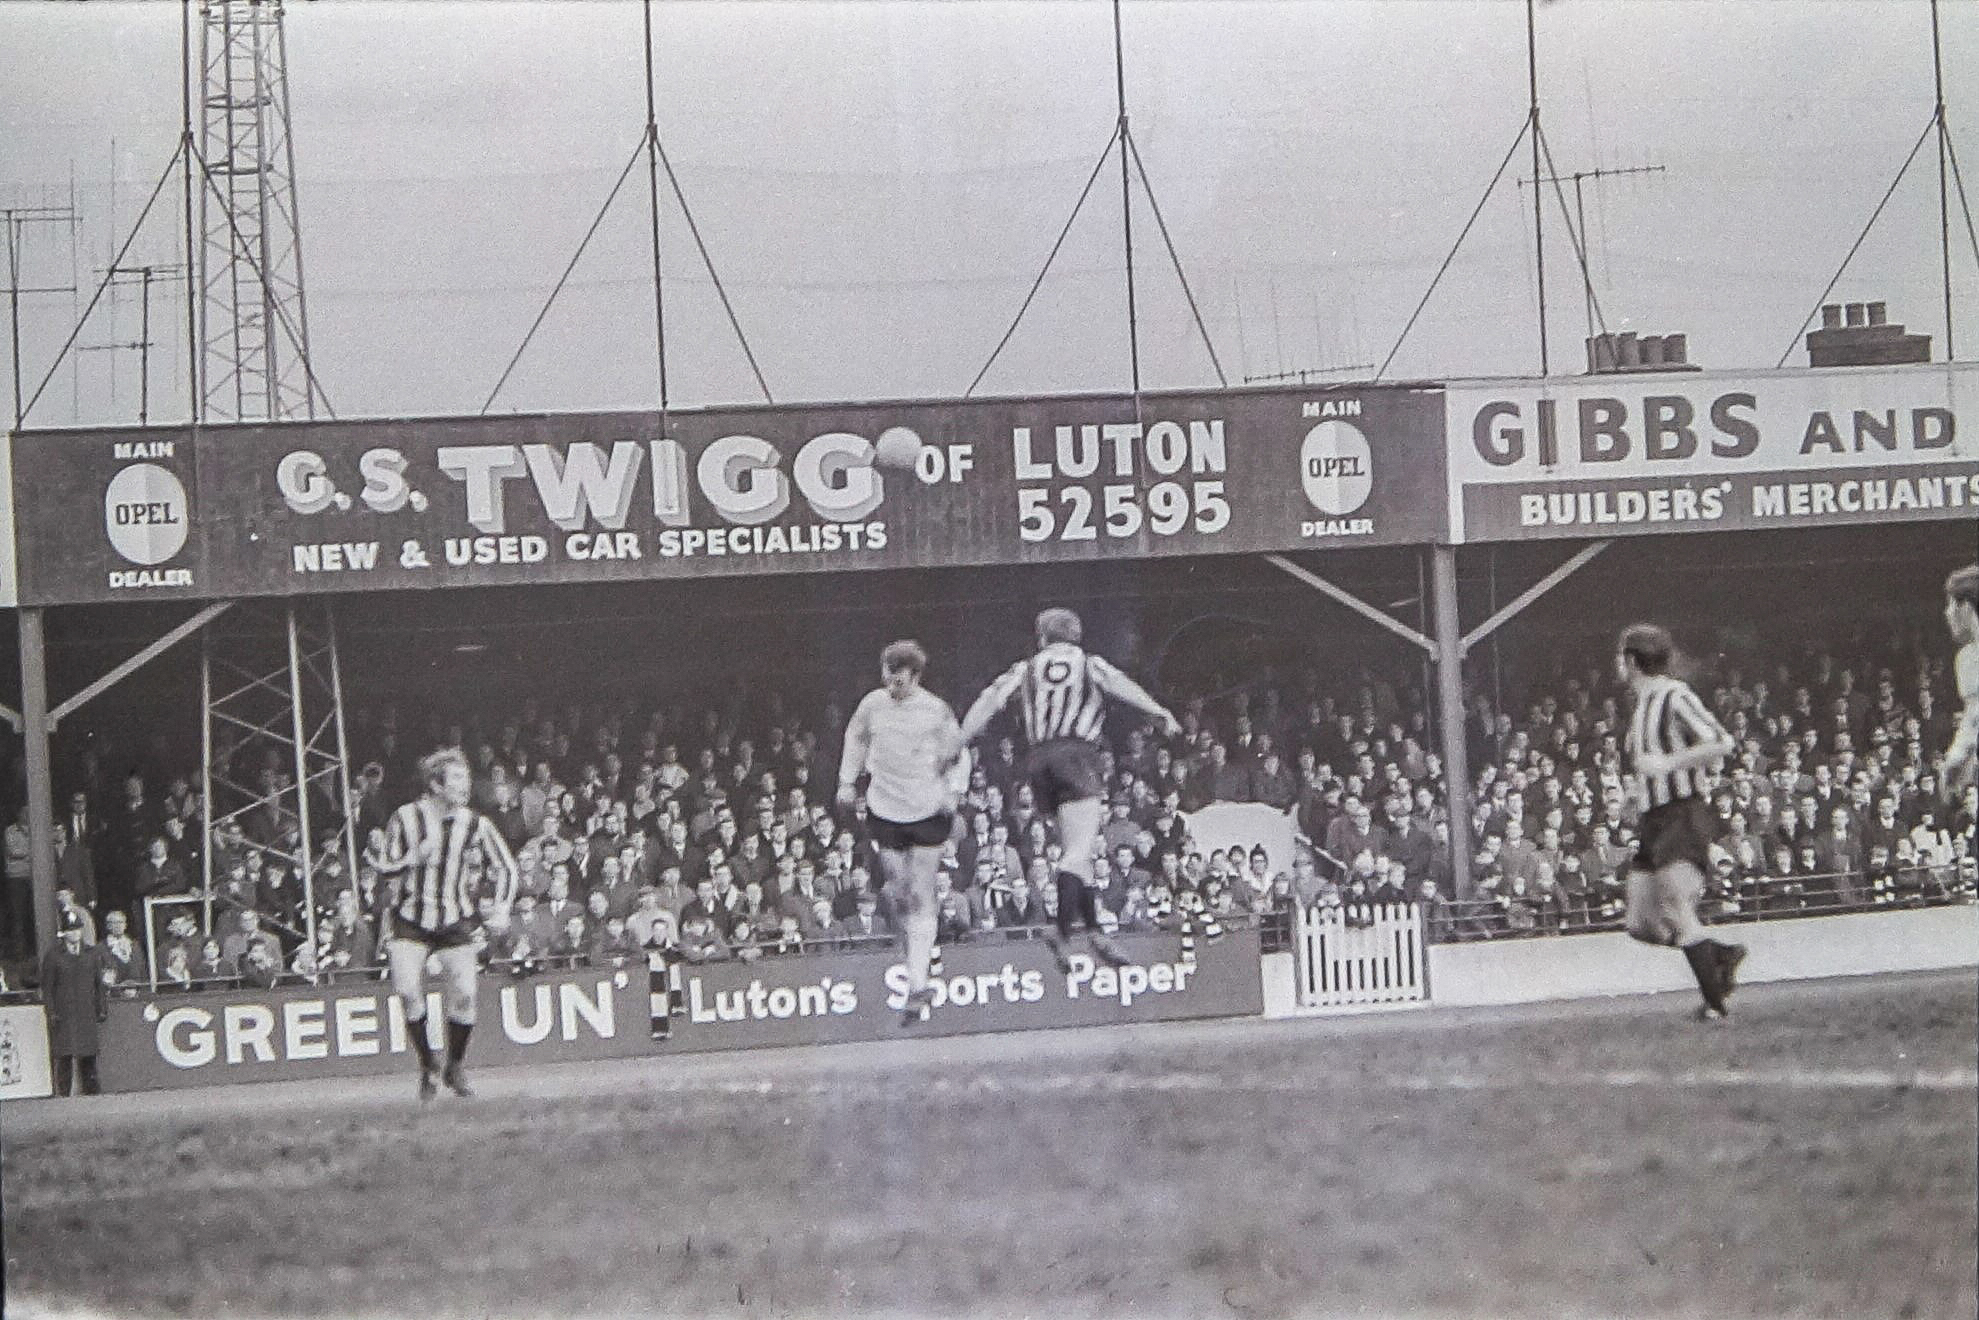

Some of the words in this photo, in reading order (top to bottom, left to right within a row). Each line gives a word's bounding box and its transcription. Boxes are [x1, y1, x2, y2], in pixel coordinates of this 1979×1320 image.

[1302, 400, 1362, 418] MAIN
[1472, 392, 1761, 467] GIBBS
[1800, 407, 1956, 455] AND
[113, 441, 175, 459] MAIN
[1012, 419, 1227, 480] LUTON
[1308, 455, 1366, 478] OPEL
[437, 432, 885, 534] TWIGG
[915, 444, 974, 484] OF
[115, 502, 179, 525] OPEL
[1017, 481, 1232, 542] 52595
[1301, 518, 1374, 537] DEALER
[292, 541, 380, 572] NEW
[400, 540, 430, 569] &
[445, 535, 549, 566] USED
[565, 533, 642, 561] CAR
[658, 521, 888, 558] SPECIALISTS
[109, 569, 194, 588] DEALER
[689, 977, 857, 1024] Luton's
[1066, 953, 1197, 1007] Paper
